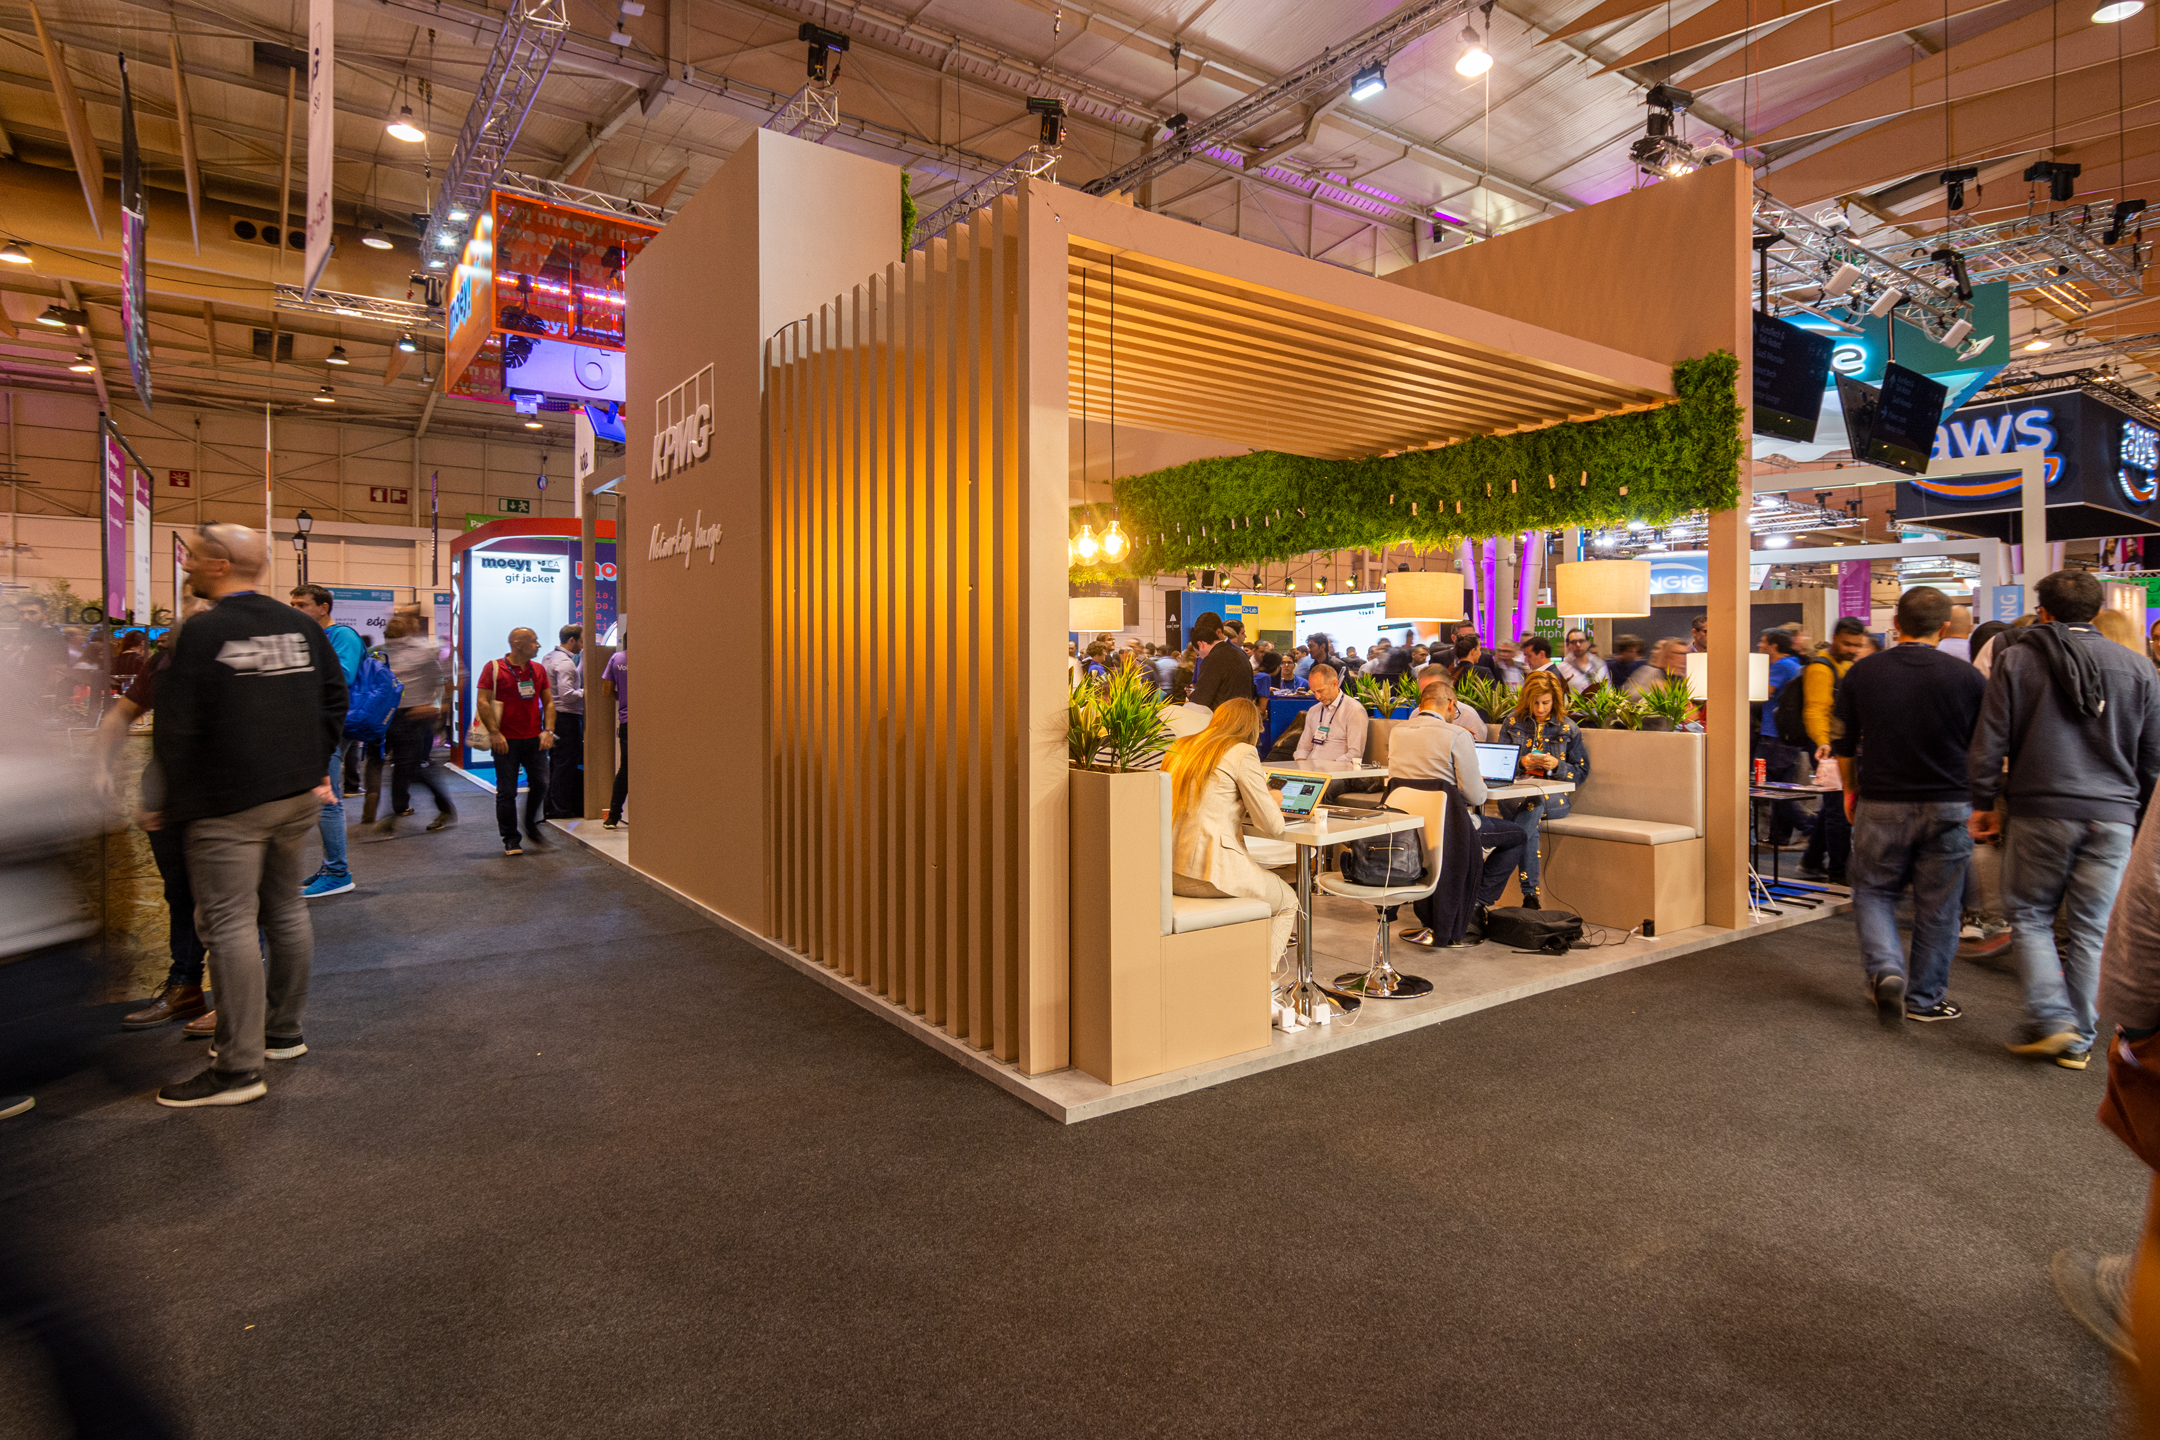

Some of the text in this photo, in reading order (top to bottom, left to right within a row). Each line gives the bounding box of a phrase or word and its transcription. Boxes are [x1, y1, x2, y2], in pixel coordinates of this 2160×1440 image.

[651, 403, 711, 480] KPMG
[1932, 409, 2052, 460] aws
[481, 557, 532, 572] moey!
[505, 573, 555, 585] gif jacket
[366, 616, 386, 629] edp
